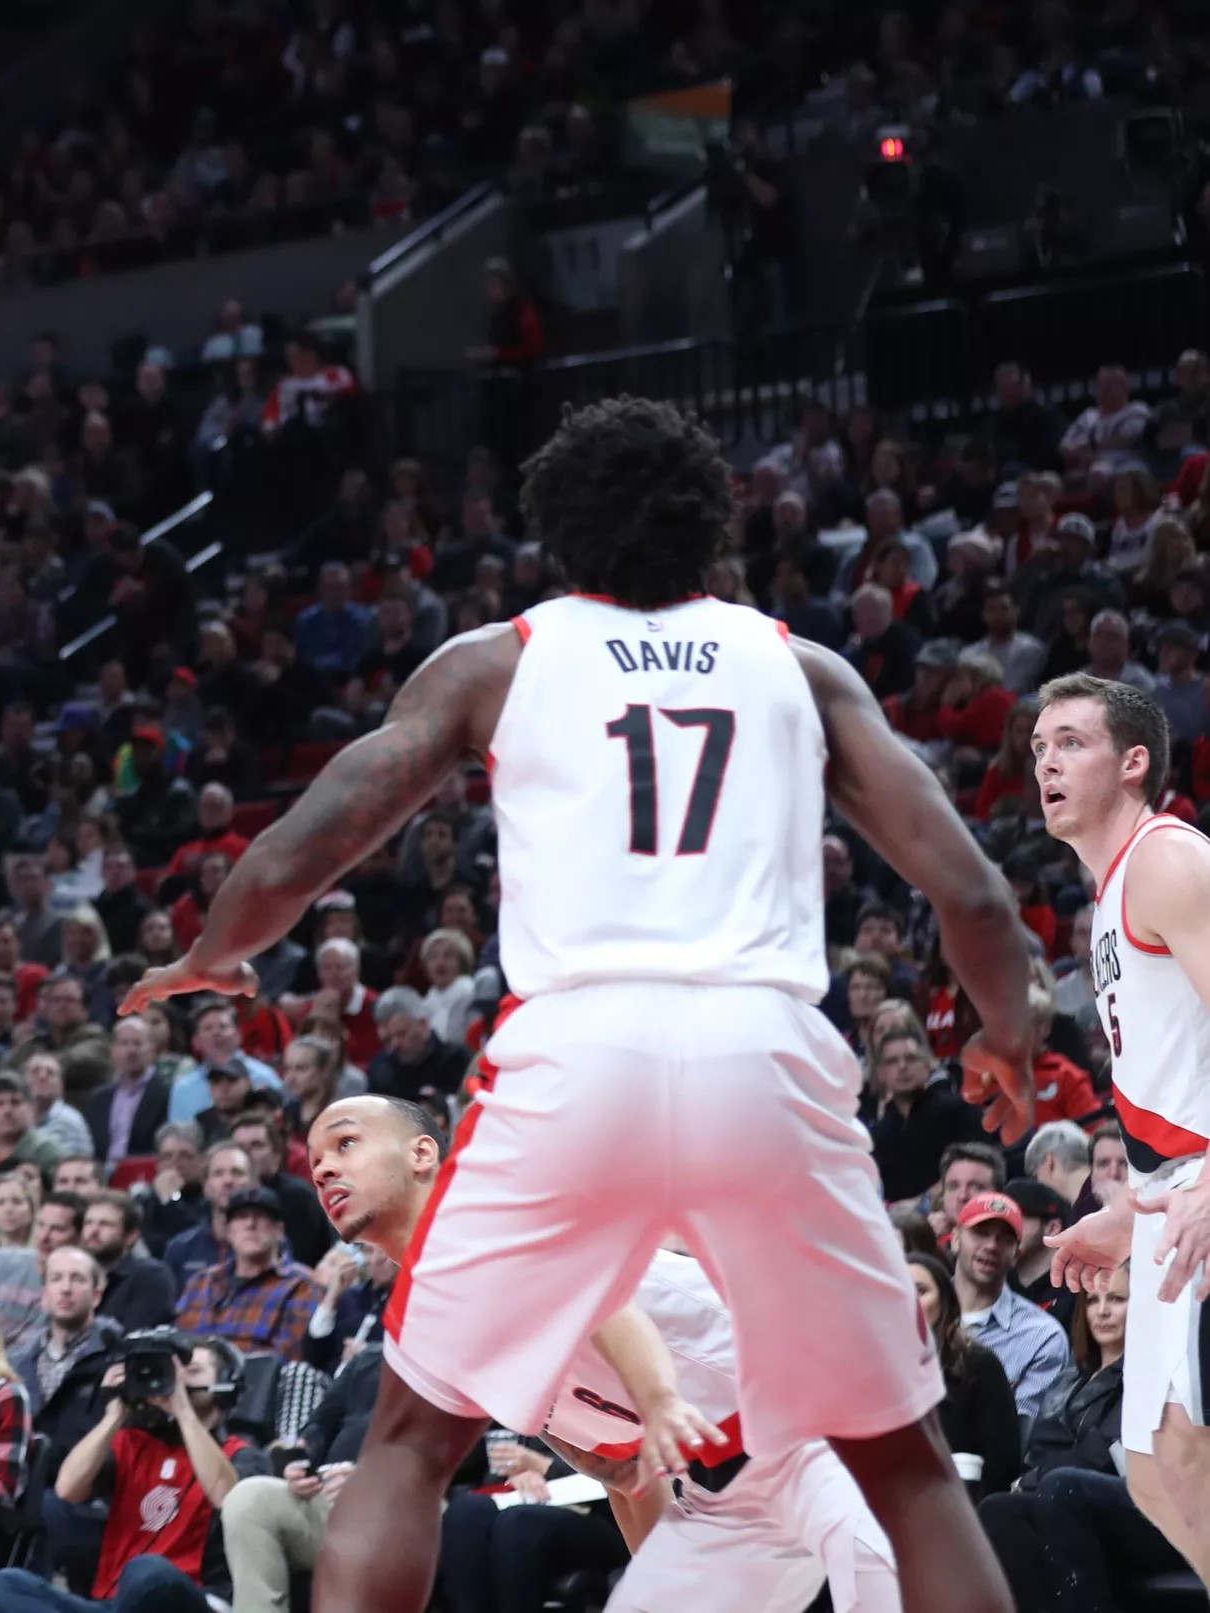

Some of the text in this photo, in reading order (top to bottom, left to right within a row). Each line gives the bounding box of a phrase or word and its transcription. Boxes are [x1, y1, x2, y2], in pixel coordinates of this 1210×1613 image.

[605, 639, 719, 674] DAVIS
[605, 703, 736, 856] 17
[1107, 992, 1122, 1058] 5
